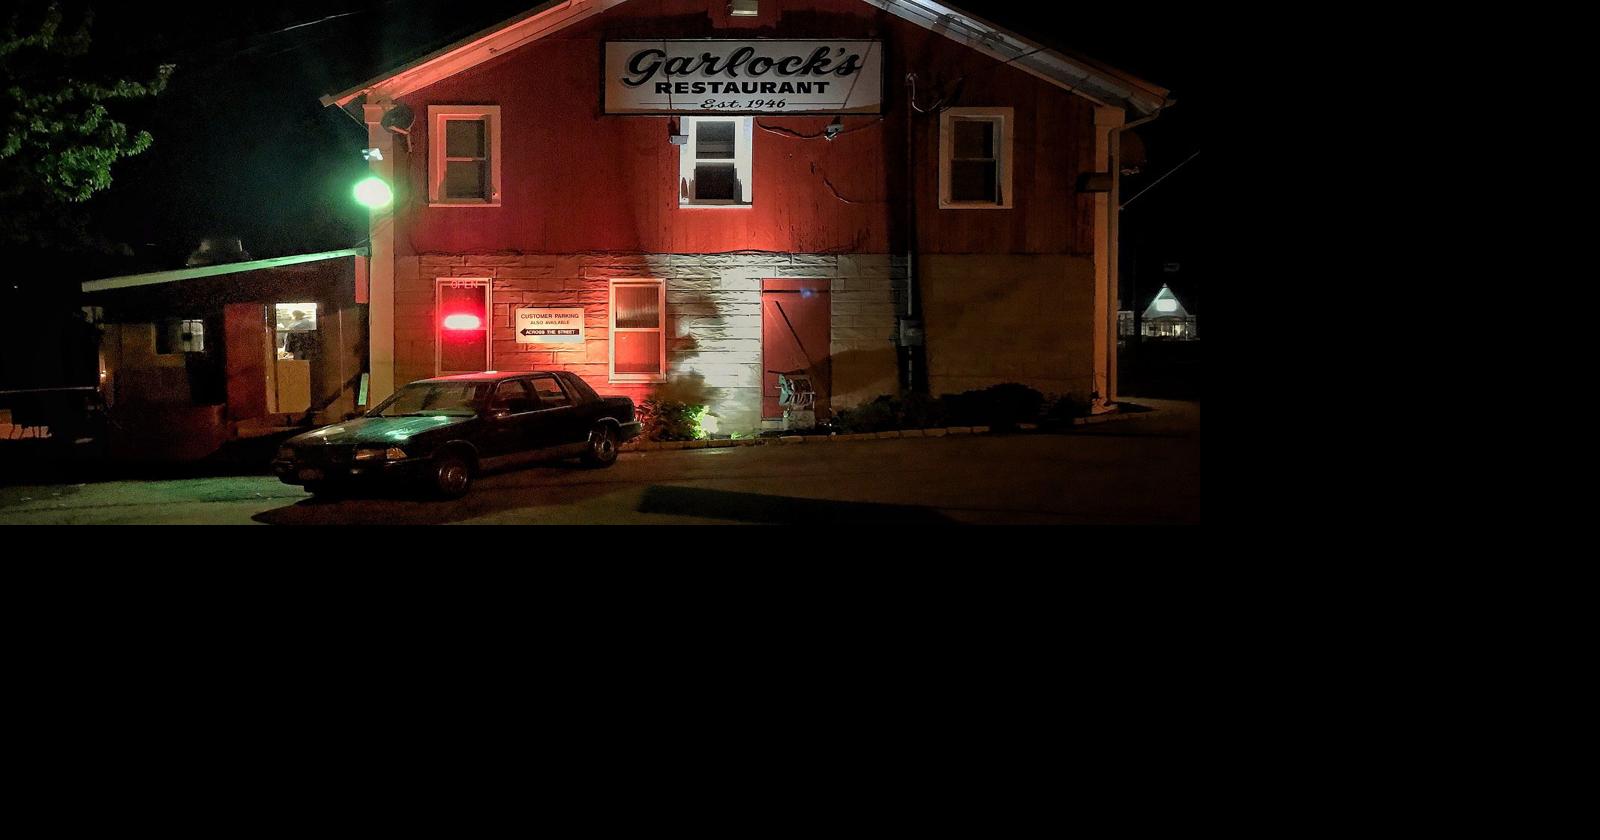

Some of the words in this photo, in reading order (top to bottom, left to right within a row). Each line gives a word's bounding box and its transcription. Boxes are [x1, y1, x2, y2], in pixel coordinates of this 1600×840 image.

[622, 46, 863, 86] Garlock's
[655, 81, 830, 94] RESTAURANT
[700, 99, 743, 110] Est.
[747, 99, 787, 110] 1946
